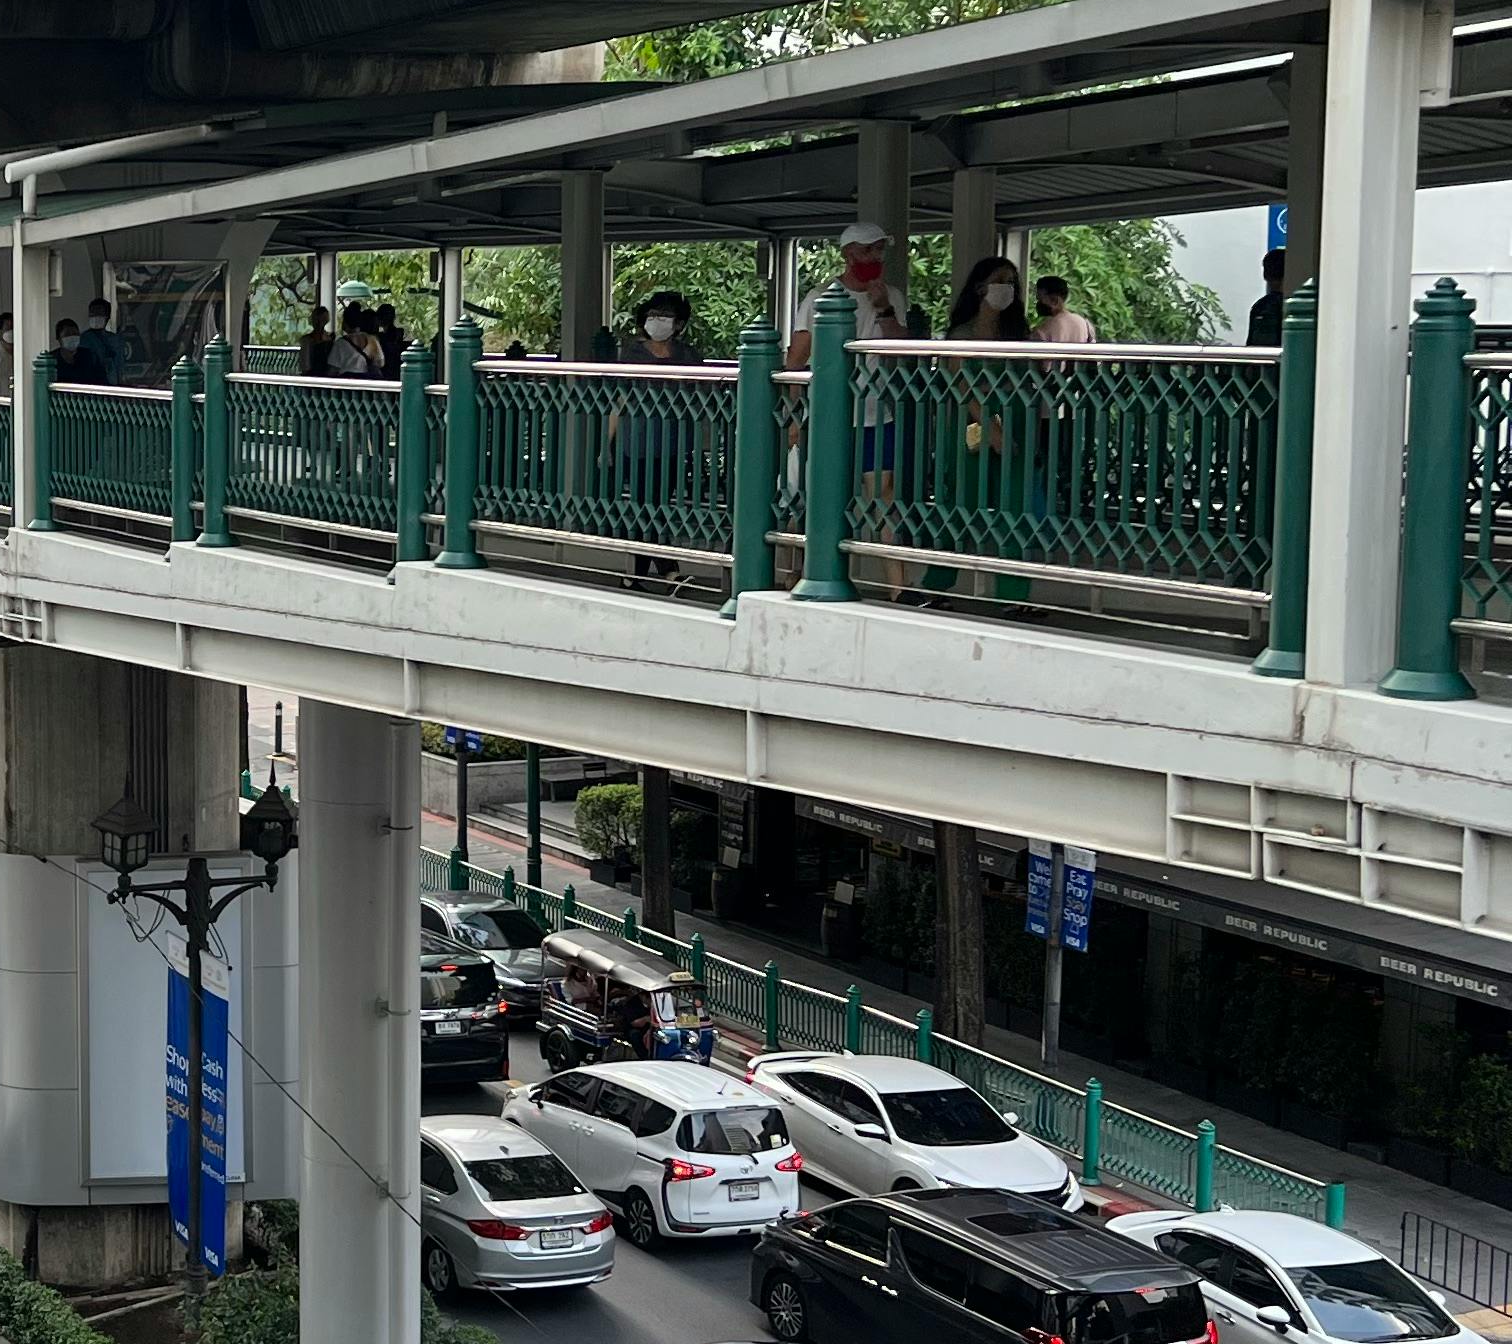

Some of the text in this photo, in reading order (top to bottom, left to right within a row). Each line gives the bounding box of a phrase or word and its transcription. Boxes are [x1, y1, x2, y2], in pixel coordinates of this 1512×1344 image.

[813, 805, 883, 834] BEER REPUBLIC
[917, 836, 936, 850] BEE
[1069, 869, 1087, 886] Eat
[1123, 887, 1180, 912] REPUBLIC
[1225, 914, 1328, 952] BEER REPUBLIC
[1380, 955, 1499, 998] BEER REPUBLIC
